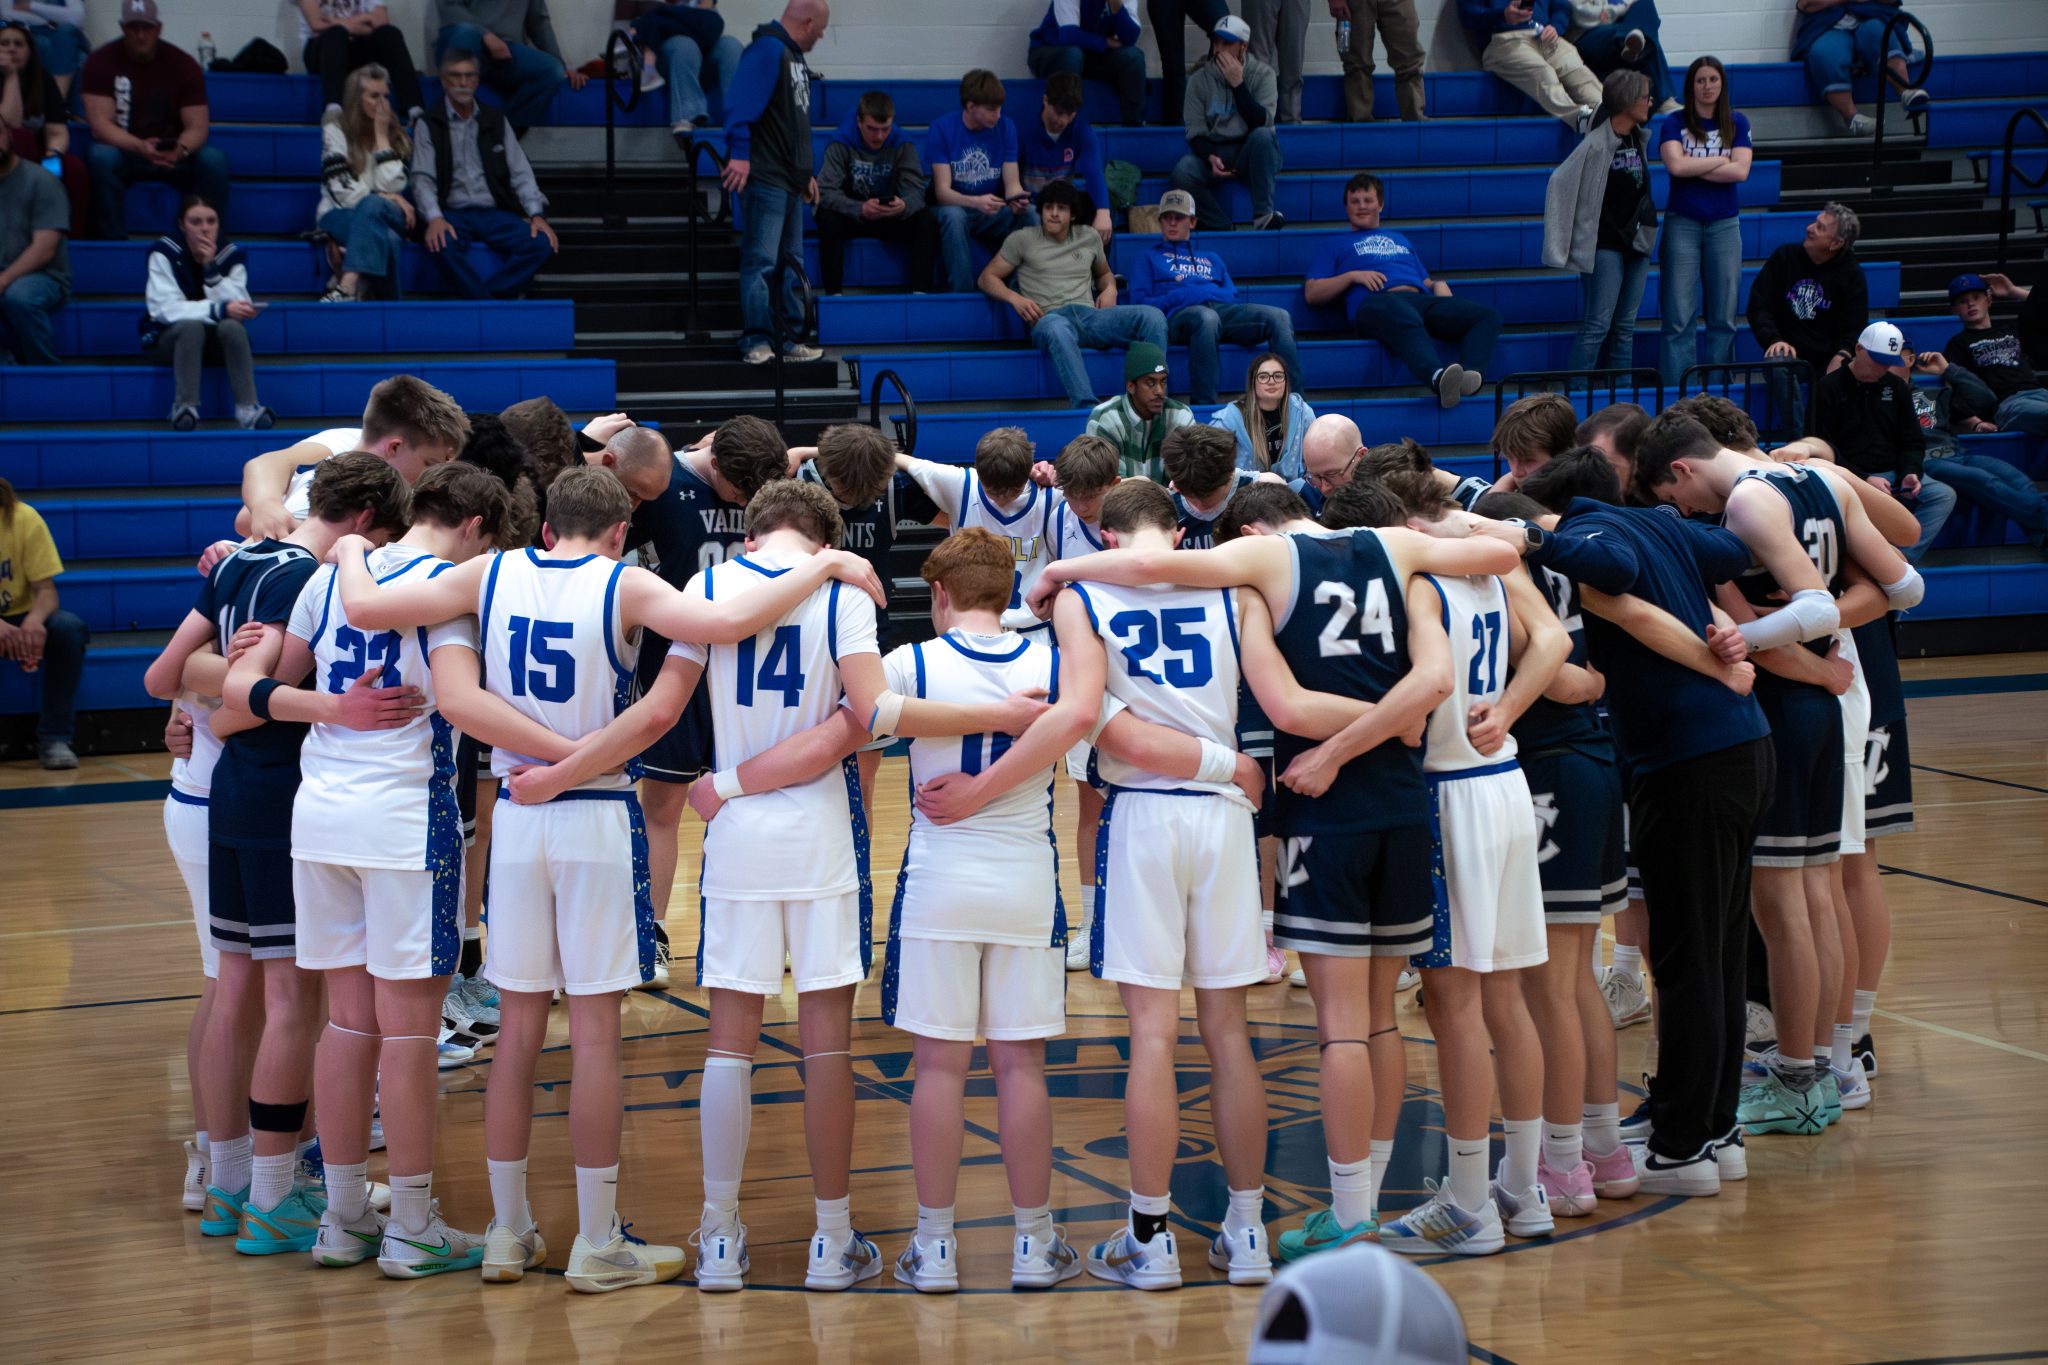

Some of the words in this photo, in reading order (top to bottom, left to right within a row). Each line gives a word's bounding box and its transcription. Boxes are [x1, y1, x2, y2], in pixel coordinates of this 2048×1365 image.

[1170, 263, 1212, 275] AKRON
[1109, 606, 1213, 689] 25
[1313, 577, 1397, 658] 24
[507, 615, 576, 704] 15
[736, 625, 806, 708] 14
